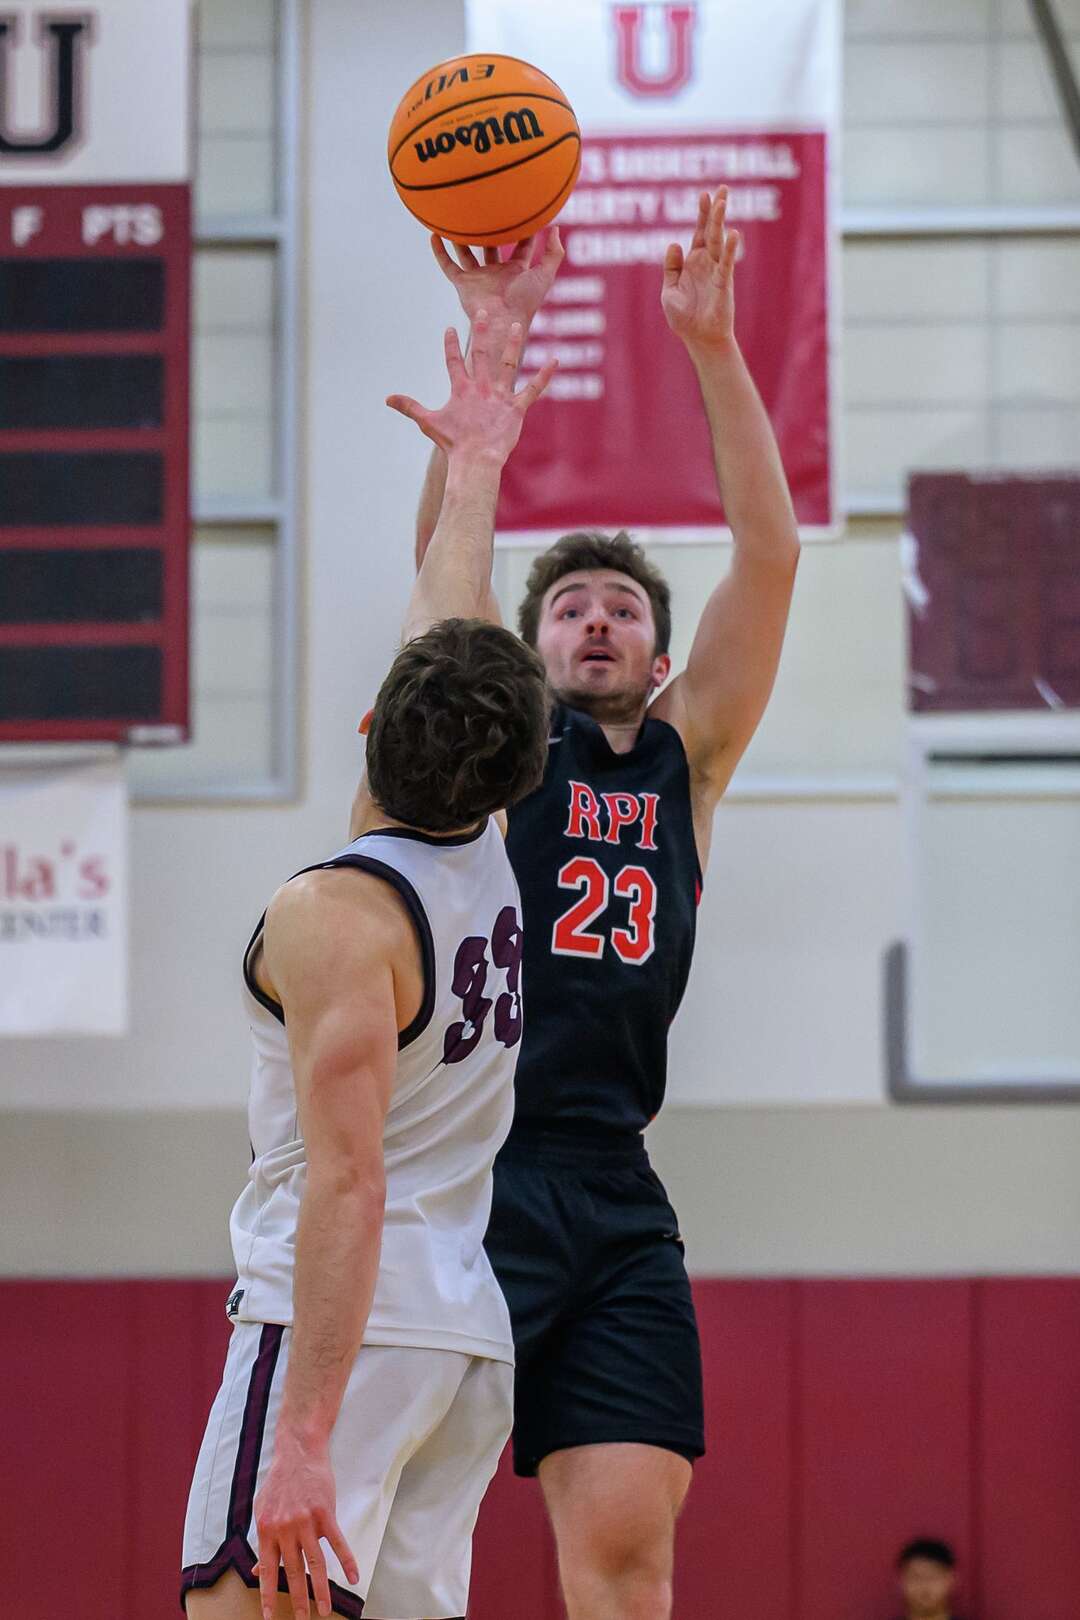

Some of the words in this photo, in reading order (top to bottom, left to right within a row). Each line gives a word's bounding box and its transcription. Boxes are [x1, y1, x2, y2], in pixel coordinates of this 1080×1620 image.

[425, 64, 495, 101] EVO
[613, 4, 696, 99] U
[414, 107, 545, 163] Wilson
[12, 206, 43, 247] F
[82, 203, 163, 247] PTS
[563, 780, 660, 851] RPI
[551, 856, 657, 966] 23
